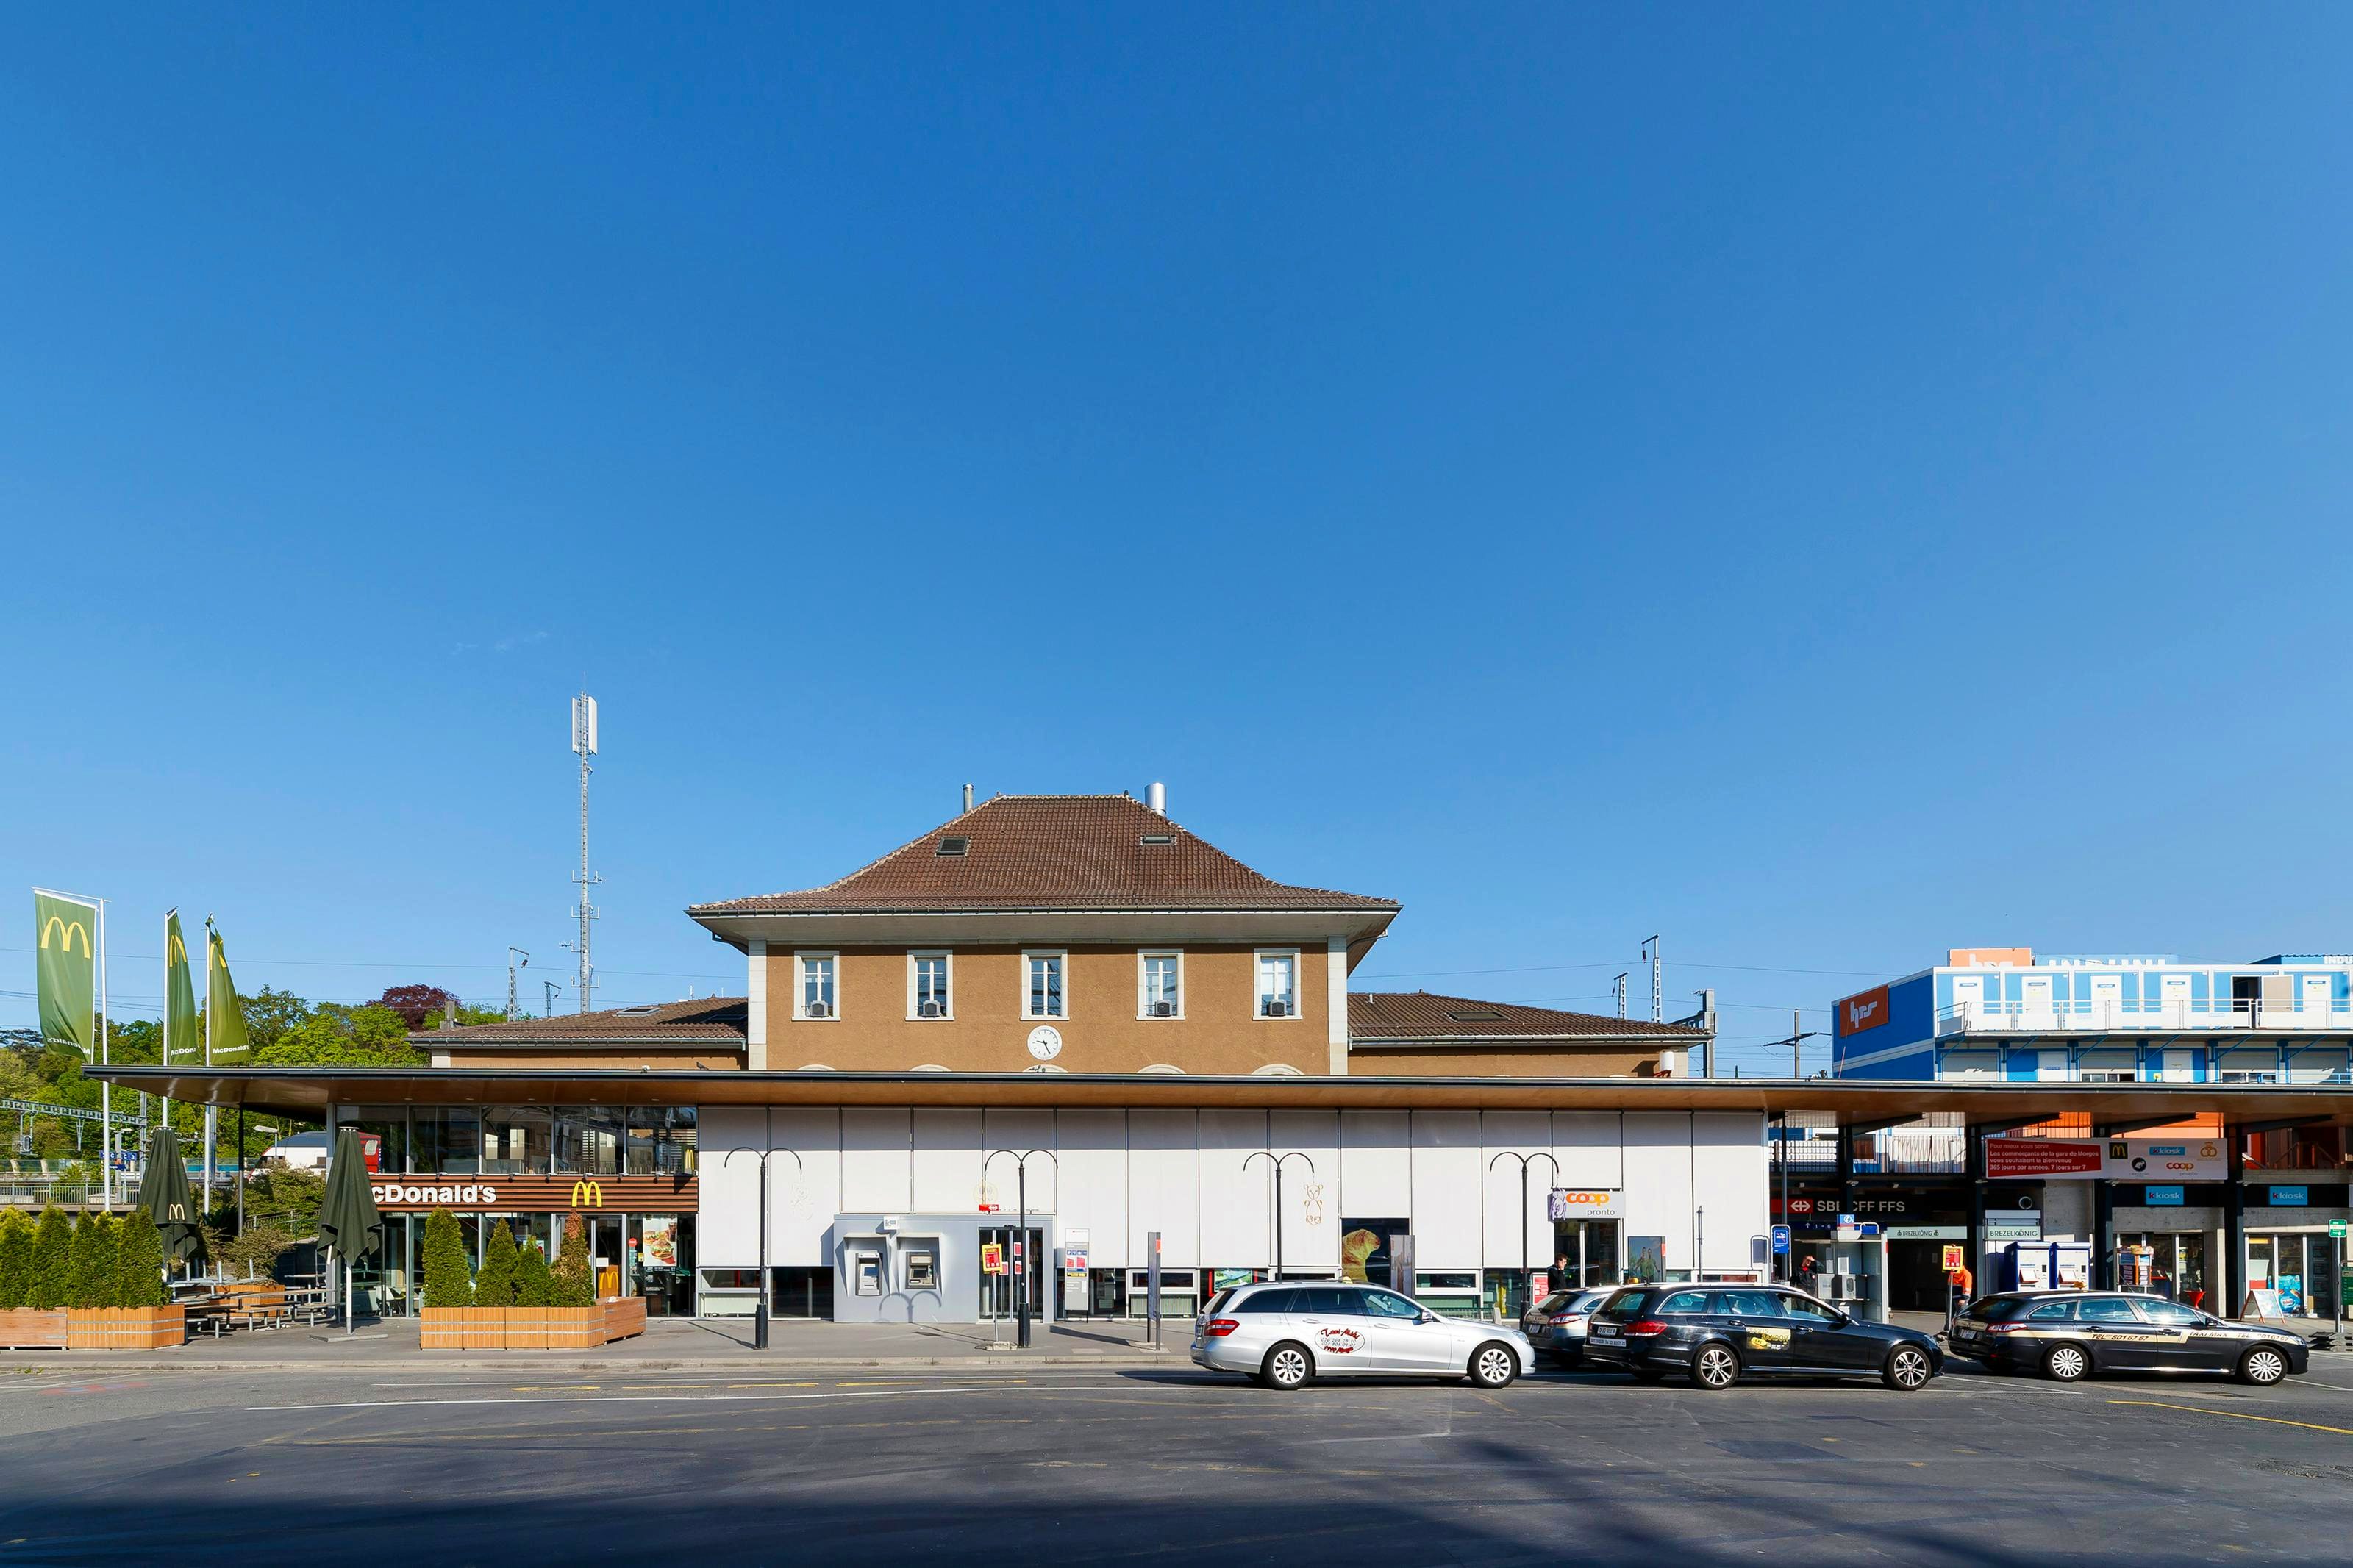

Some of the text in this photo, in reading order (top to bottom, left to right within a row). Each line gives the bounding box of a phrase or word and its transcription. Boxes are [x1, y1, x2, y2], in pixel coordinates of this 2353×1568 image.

[1850, 1001, 1877, 1028] hrs
[2166, 1162, 2194, 1170] coop
[371, 1184, 496, 1203] cDonald's
[1566, 1192, 1610, 1206] coop
[1879, 1201, 1905, 1212] FFS
